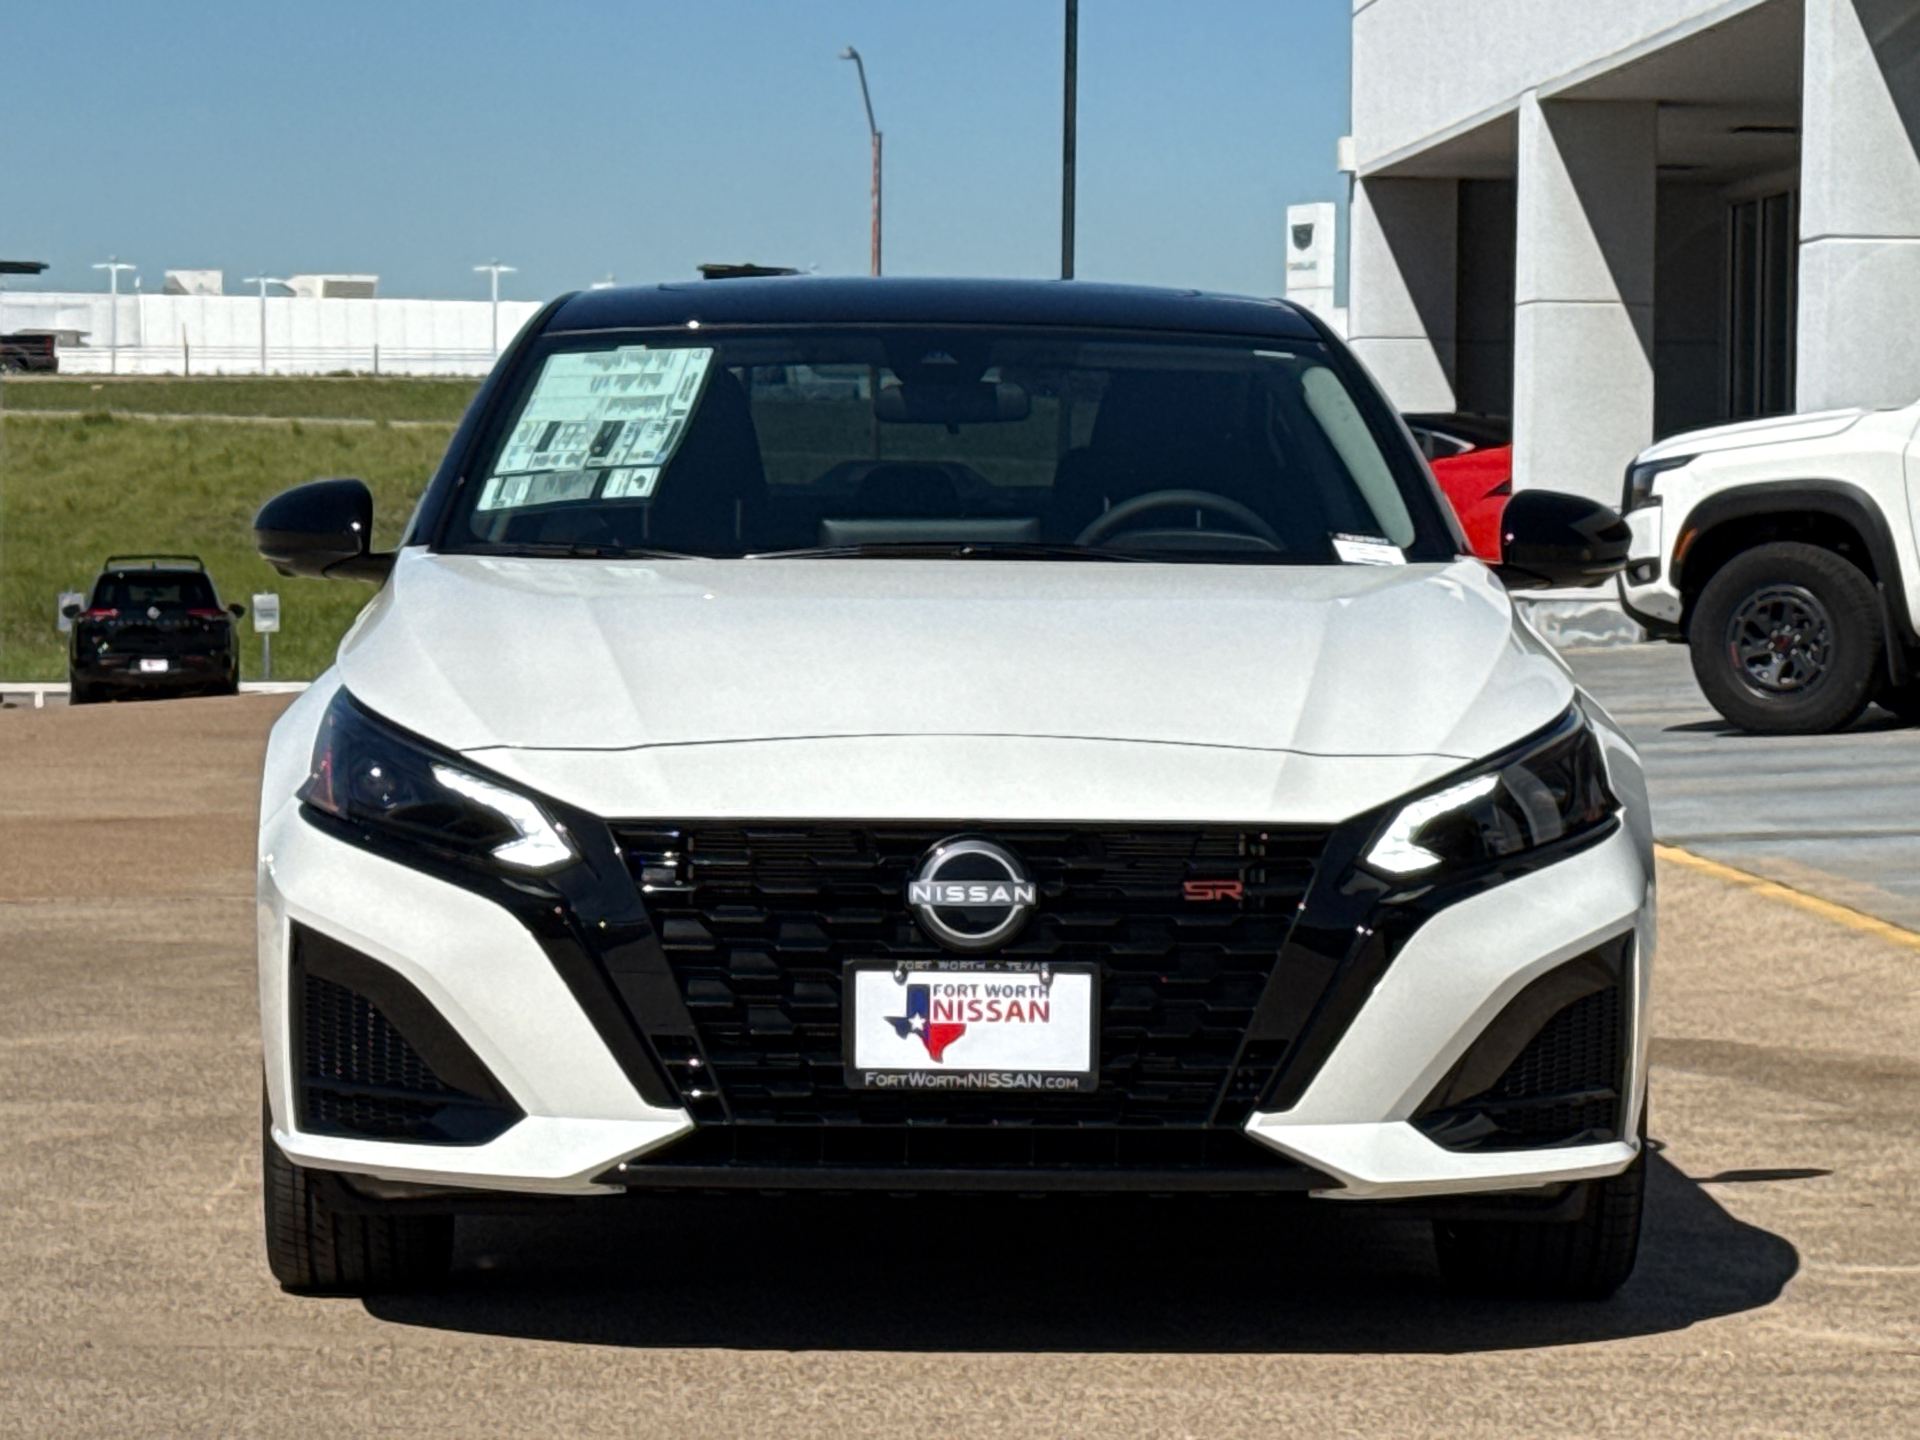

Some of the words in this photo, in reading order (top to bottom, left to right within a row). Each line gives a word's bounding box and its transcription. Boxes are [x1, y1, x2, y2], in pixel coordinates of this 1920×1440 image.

[912, 885, 1033, 902] NISSAN
[1183, 880, 1243, 901] SR
[897, 960, 932, 970] FORT
[938, 960, 986, 970] WORTH
[1005, 961, 1049, 971] TEXAS
[933, 983, 978, 998] FORT
[984, 984, 1050, 999] WORTH
[933, 999, 1050, 1023] NISSAN
